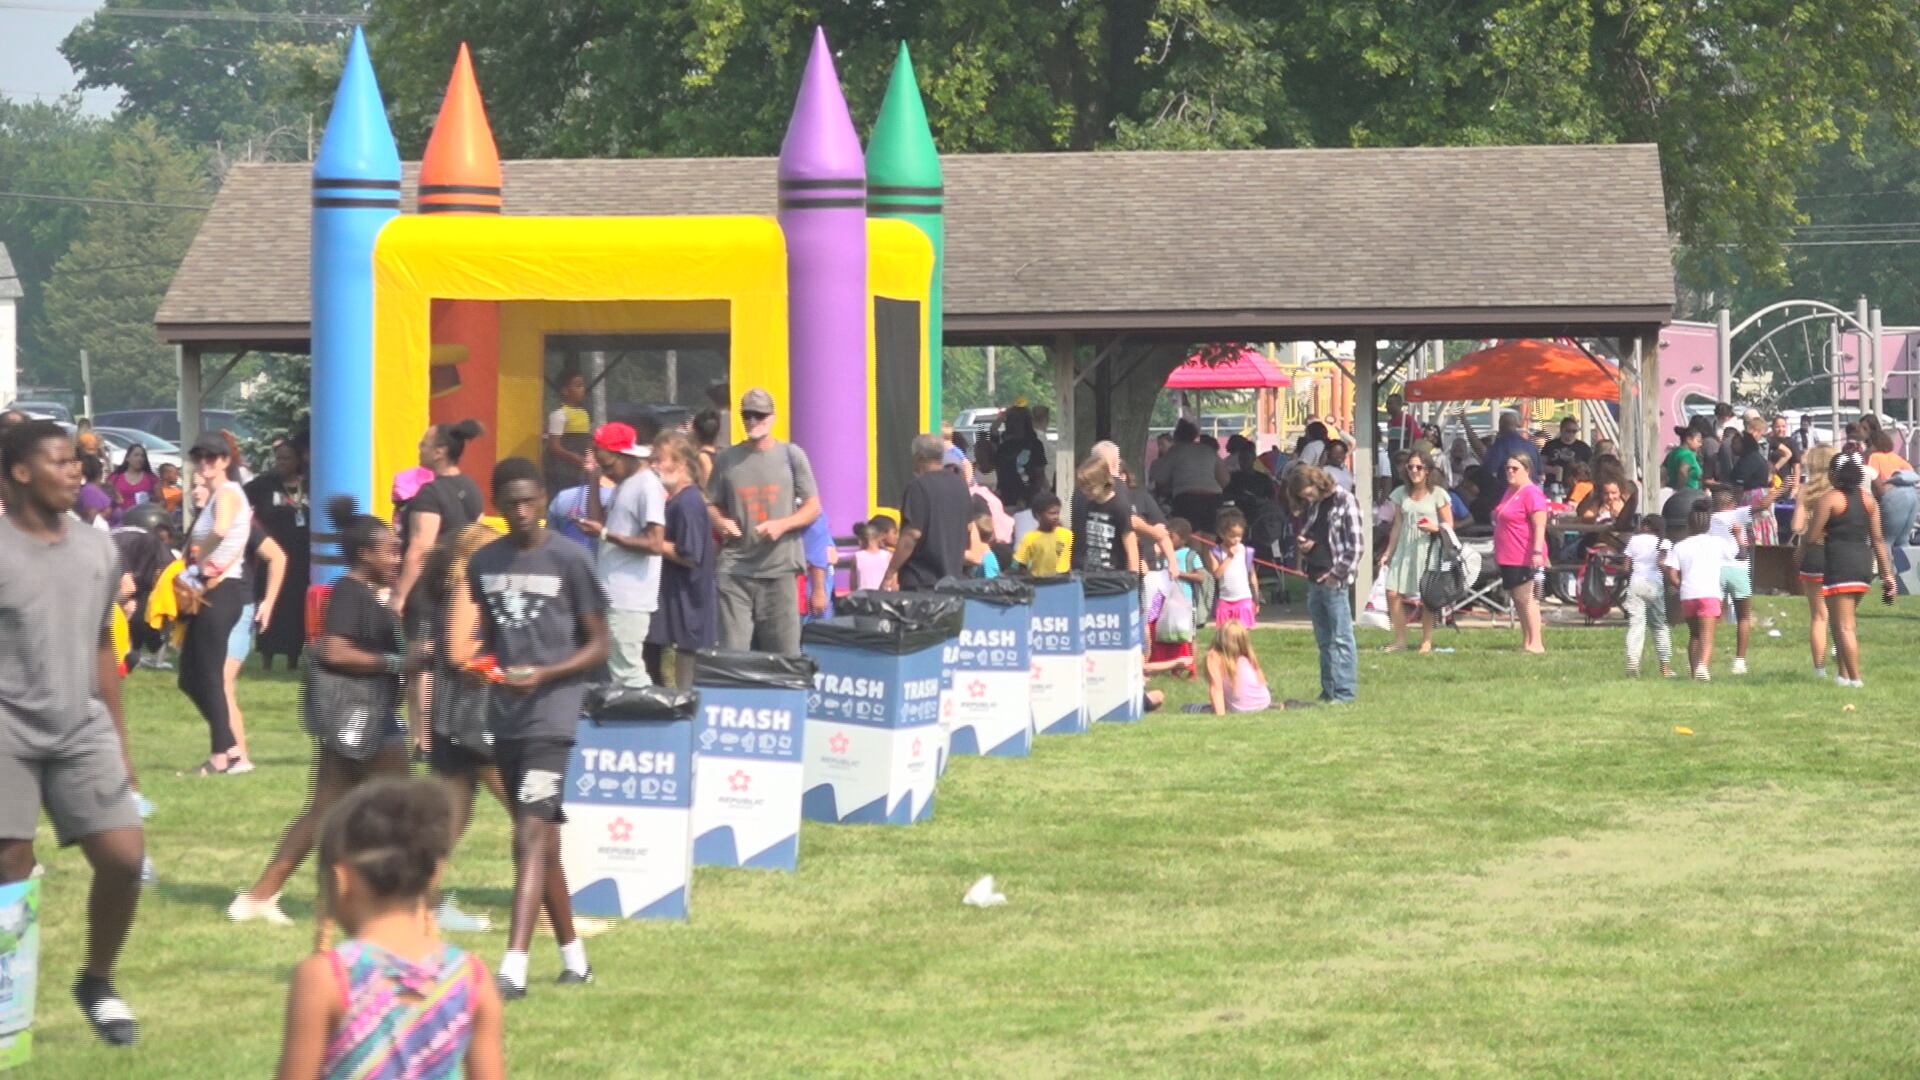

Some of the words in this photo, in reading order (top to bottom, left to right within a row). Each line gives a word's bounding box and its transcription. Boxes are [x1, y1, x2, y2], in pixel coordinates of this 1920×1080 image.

[1032, 616, 1069, 632] ASH
[1085, 613, 1120, 629] ASH
[960, 629, 1016, 647] RASH
[813, 672, 885, 700] TRASH
[903, 678, 939, 701] TRASH
[705, 705, 792, 731] TRASH
[581, 748, 675, 775] TRASH
